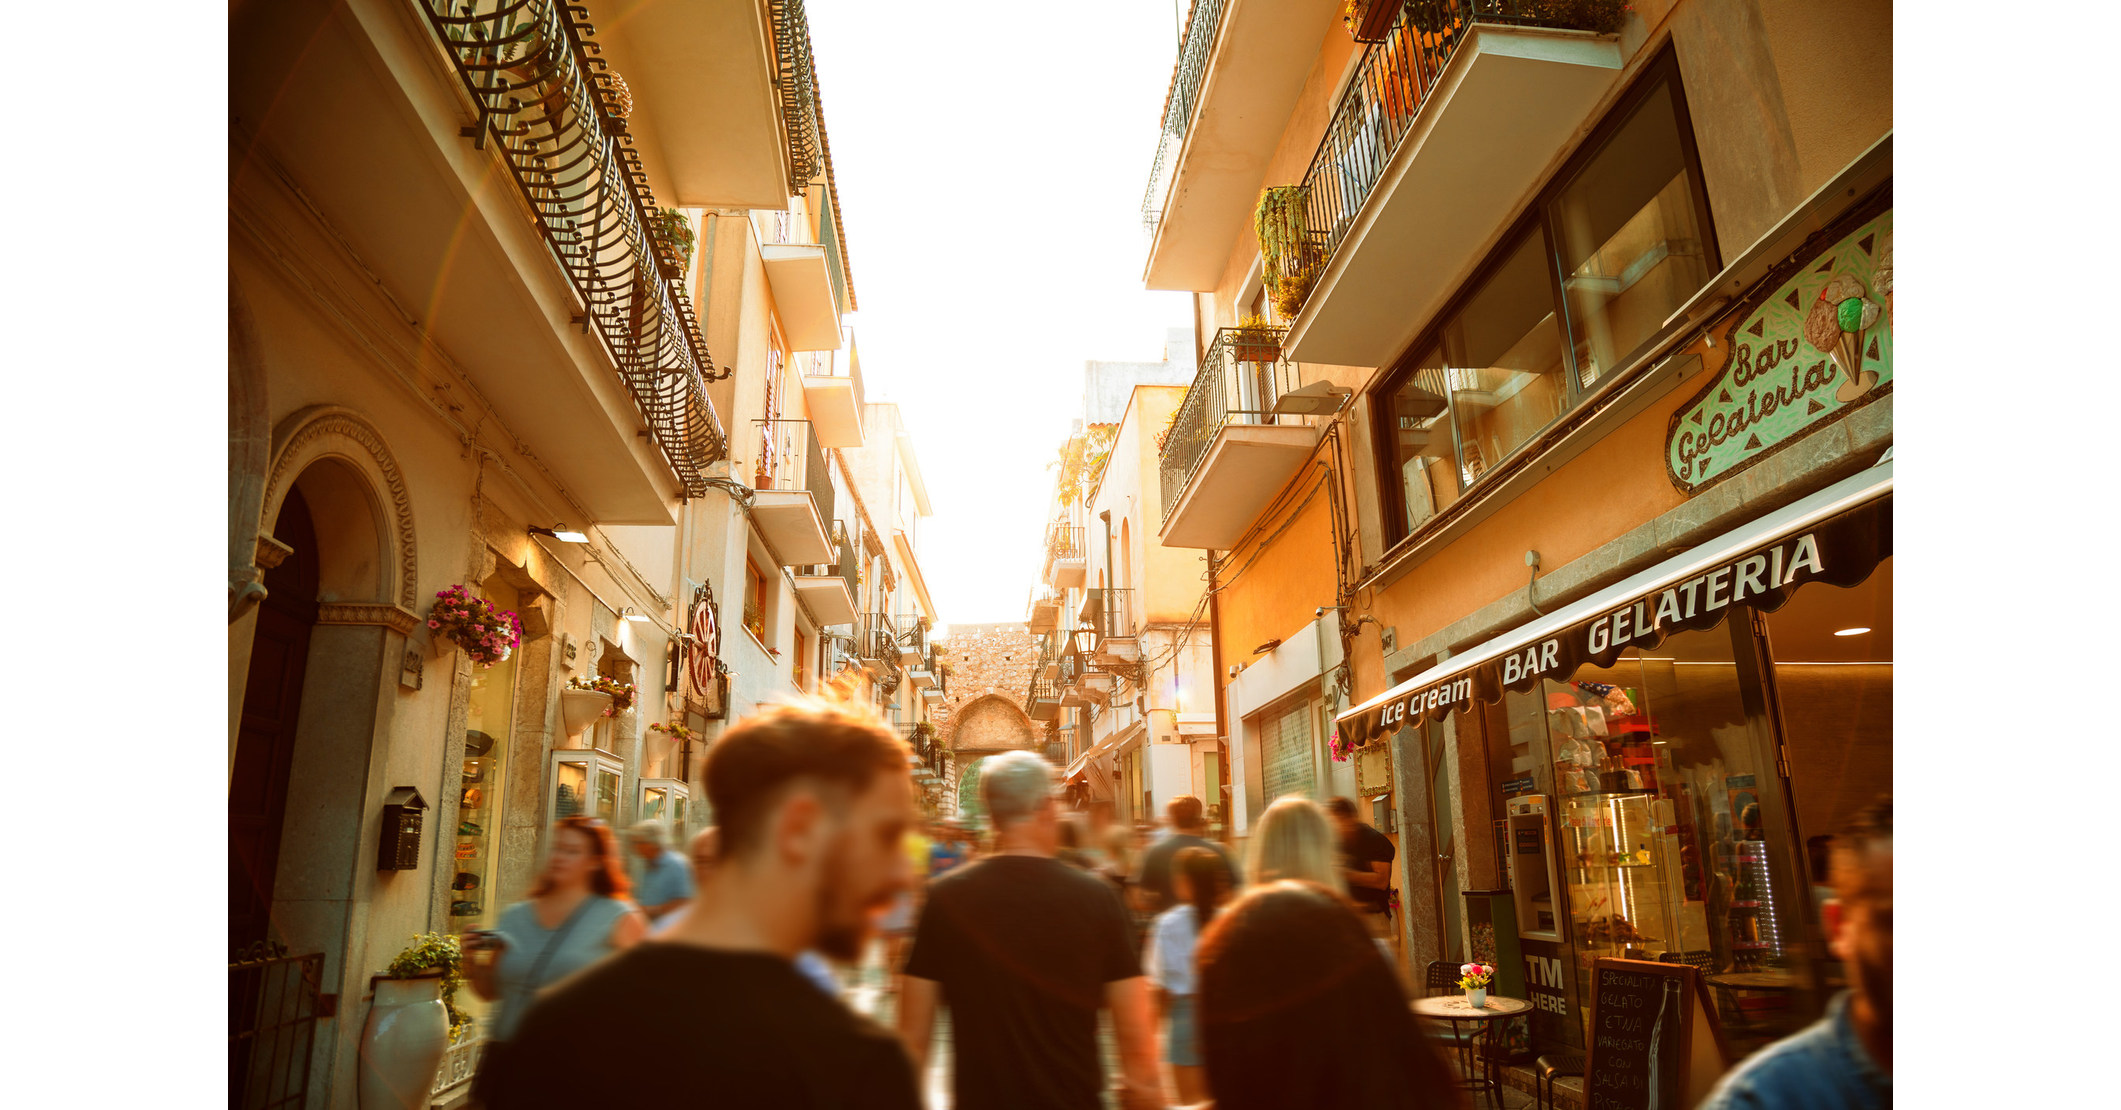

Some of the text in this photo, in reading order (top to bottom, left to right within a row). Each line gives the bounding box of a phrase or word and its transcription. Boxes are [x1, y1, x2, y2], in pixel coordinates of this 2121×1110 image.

[1733, 337, 1799, 388] Bar
[1678, 359, 1837, 481] Gelateria
[1380, 533, 1825, 727] ice cream BAR GELATERIA
[1524, 954, 1564, 990] TM
[1530, 991, 1567, 1016] HERE
[1600, 992, 1643, 1009] GELATO
[1594, 1069, 1628, 1090] SALSA
